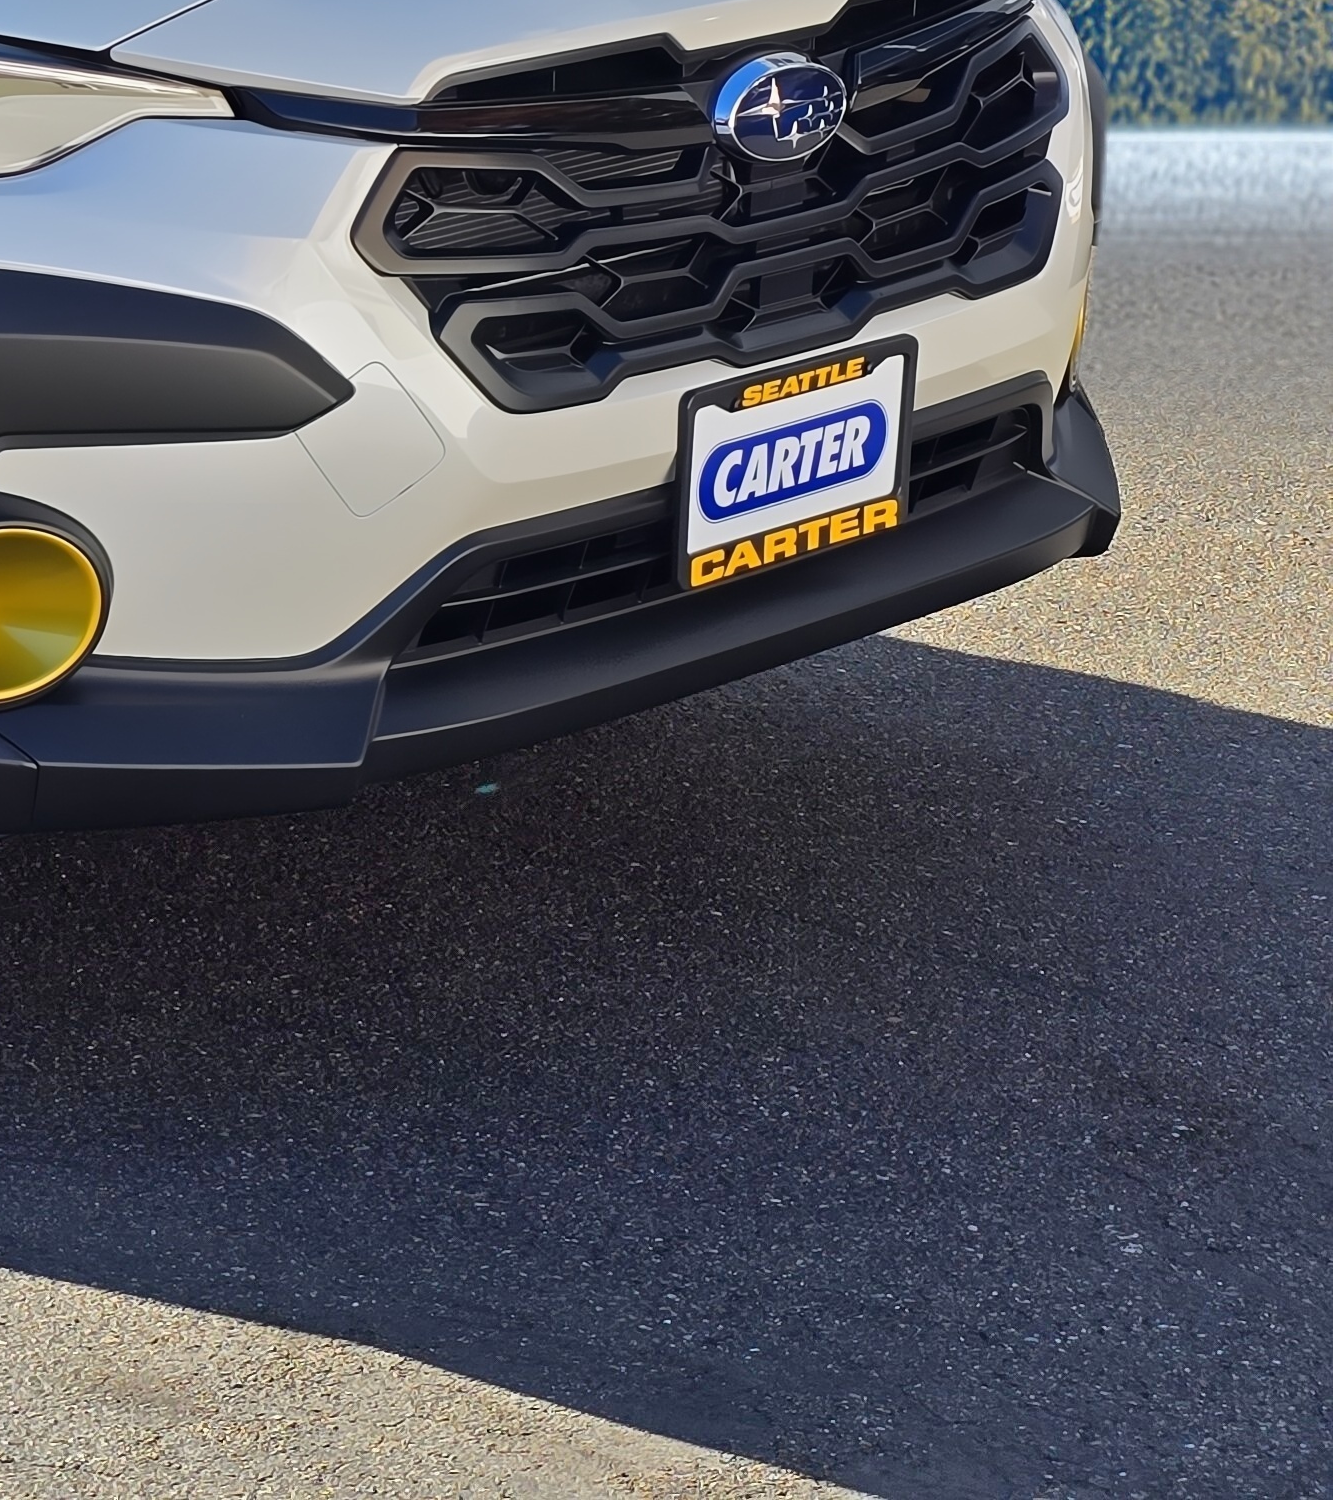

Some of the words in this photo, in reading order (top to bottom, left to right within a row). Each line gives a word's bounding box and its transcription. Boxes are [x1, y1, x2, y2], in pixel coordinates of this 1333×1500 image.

[741, 357, 866, 407] SEATTLE
[713, 415, 871, 508] CARTER
[690, 498, 899, 587] CARTER
